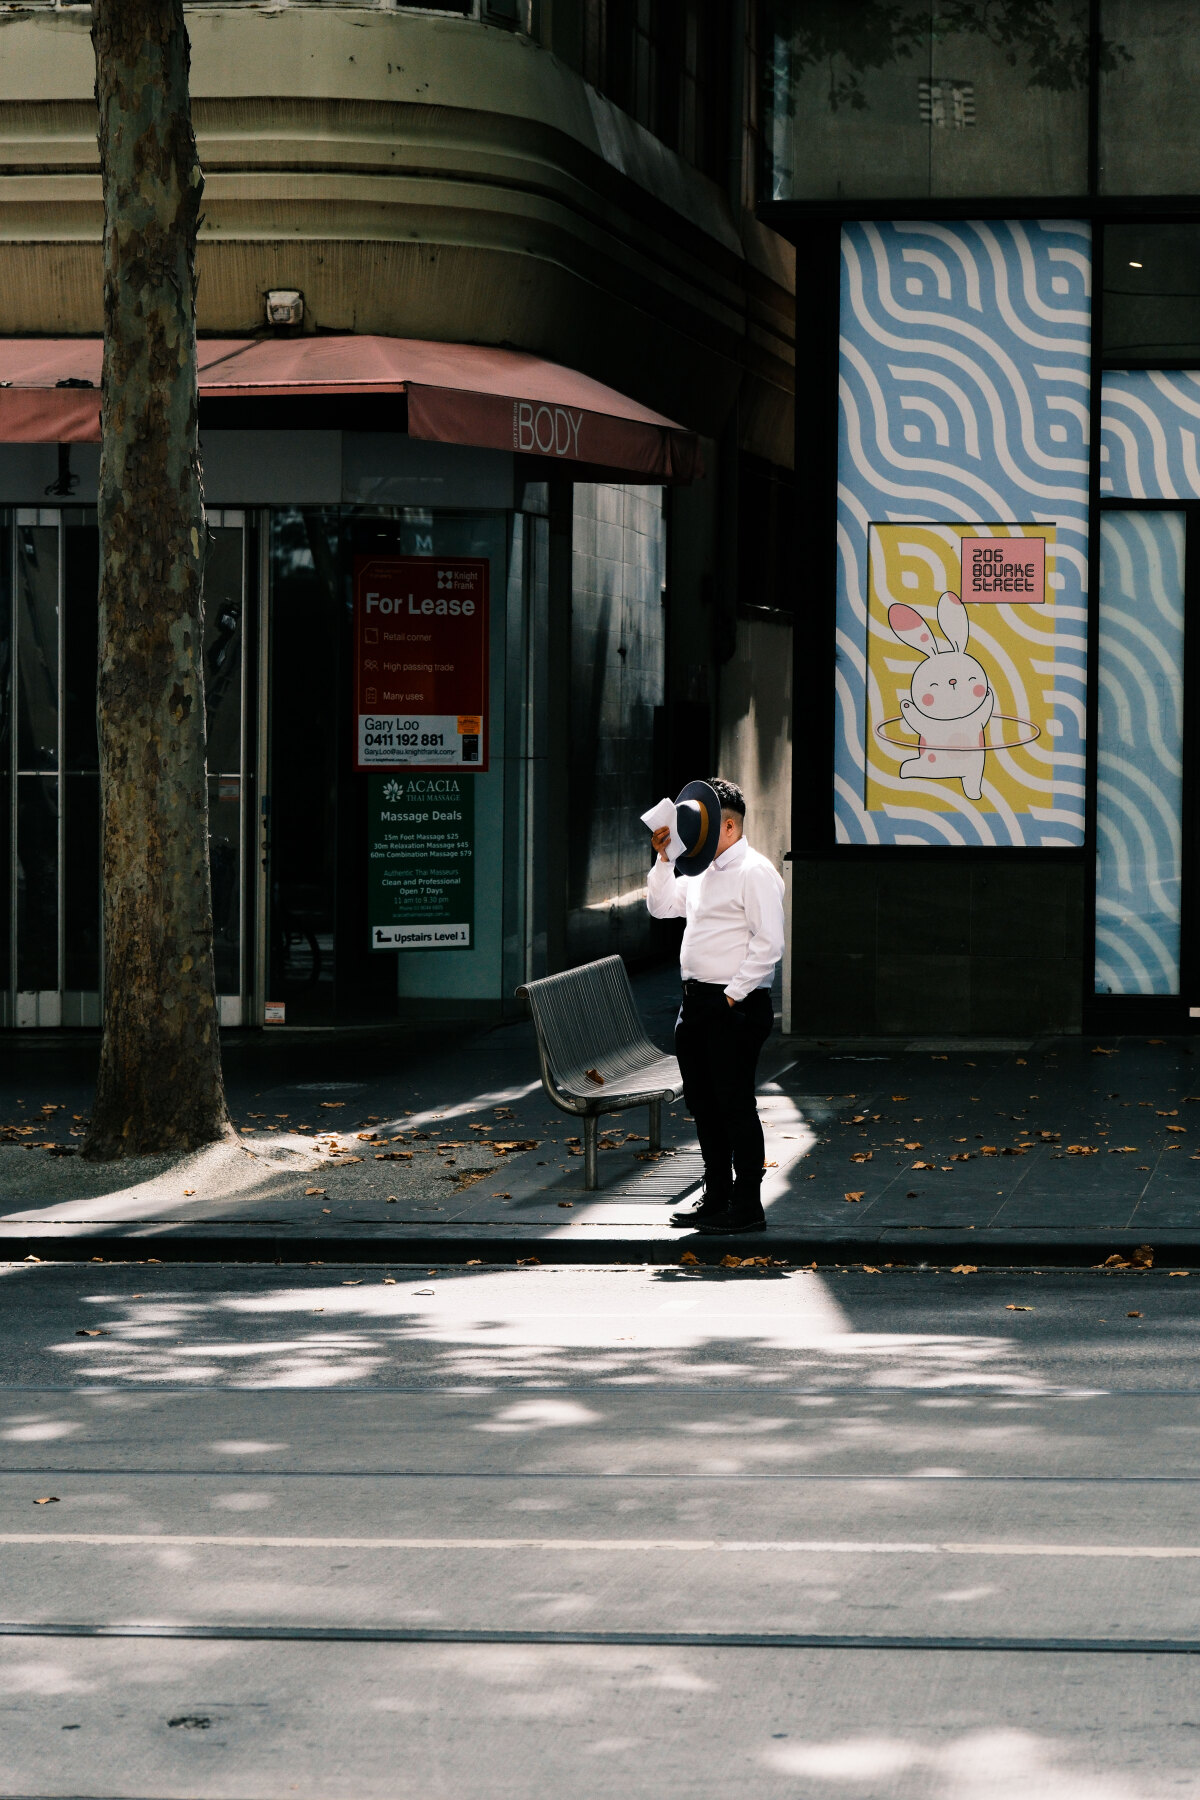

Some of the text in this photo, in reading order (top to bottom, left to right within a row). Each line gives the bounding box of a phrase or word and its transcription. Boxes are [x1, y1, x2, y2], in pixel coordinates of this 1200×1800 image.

[519, 402, 583, 456] BODY
[972, 548, 1004, 562] 206
[454, 571, 478, 582] Knight
[972, 564, 1034, 577] BOURKE
[454, 581, 474, 590] Frank
[972, 578, 1034, 592] STREET
[366, 592, 476, 616] For Lease
[384, 632, 432, 642] Retail corner
[384, 662, 454, 672] High passing trade
[384, 692, 404, 702] Many
[364, 718, 420, 732] Gary Loo
[364, 734, 444, 746] 0411 192 881
[406, 780, 460, 792] ACACIA
[380, 810, 462, 822] Massage Deals
[416, 834, 444, 842] Massage
[394, 932, 466, 944] Upstairs Level 1
